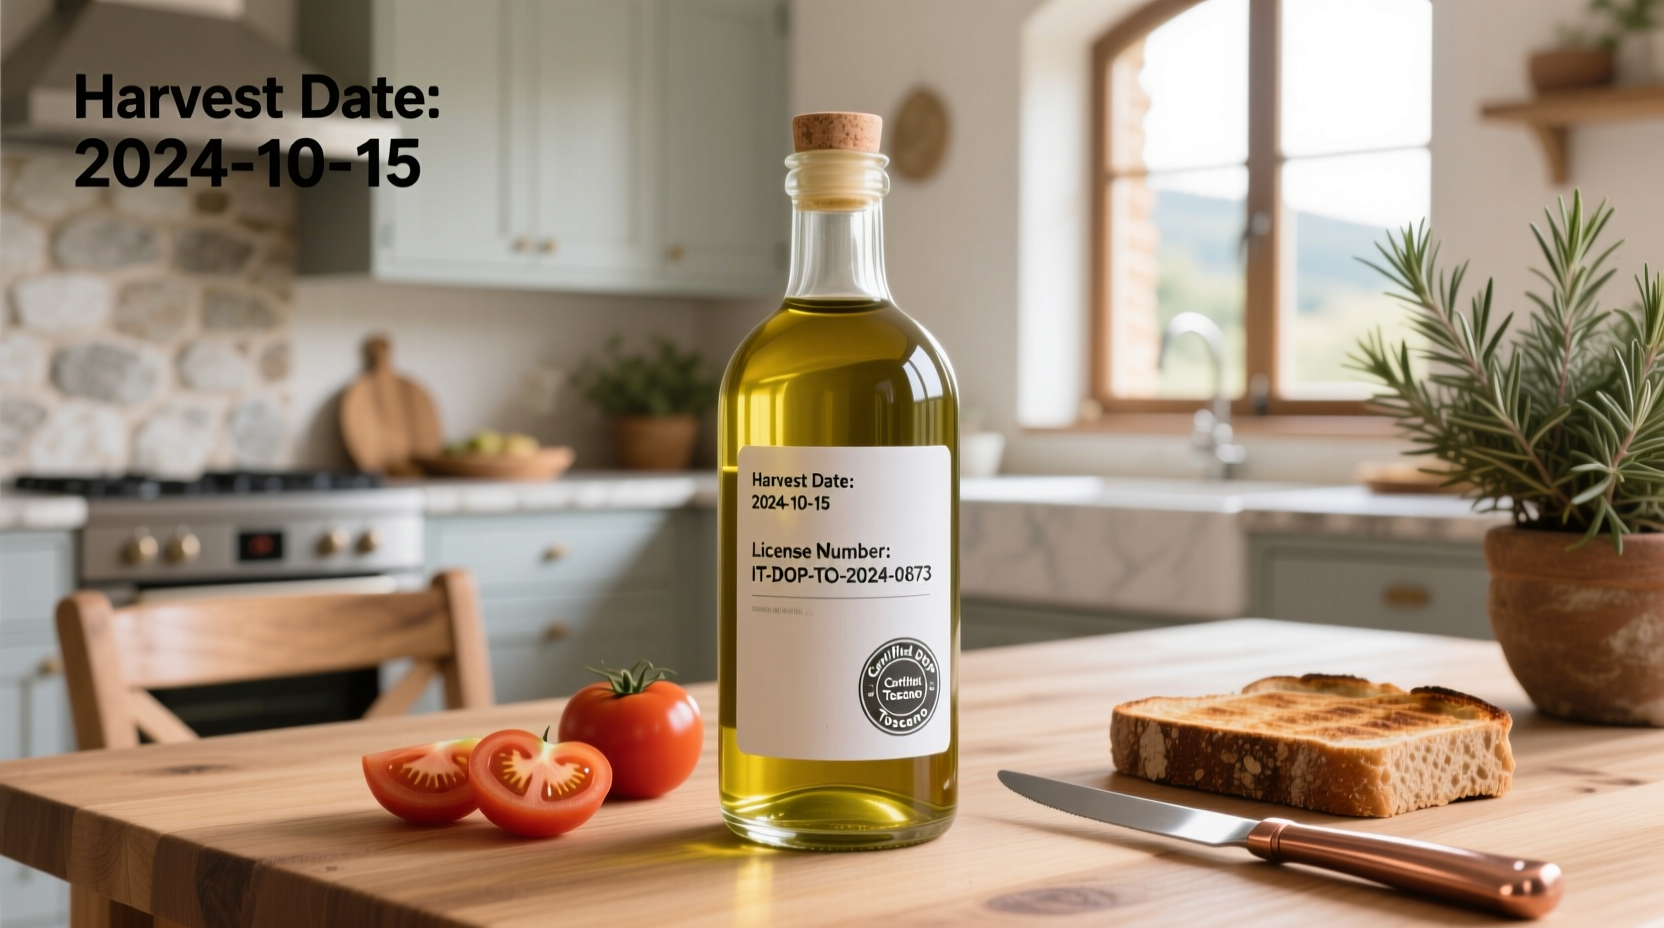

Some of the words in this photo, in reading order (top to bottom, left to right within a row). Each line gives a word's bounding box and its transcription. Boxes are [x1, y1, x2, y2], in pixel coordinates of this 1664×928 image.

[752, 472, 807, 487] Harvest
[812, 473, 854, 488] Date:
[752, 495, 830, 510] 2024-10-15
[752, 542, 812, 559] License
[817, 543, 891, 559] Number:
[752, 565, 932, 583] IT-DOP-TO-2024-0873
